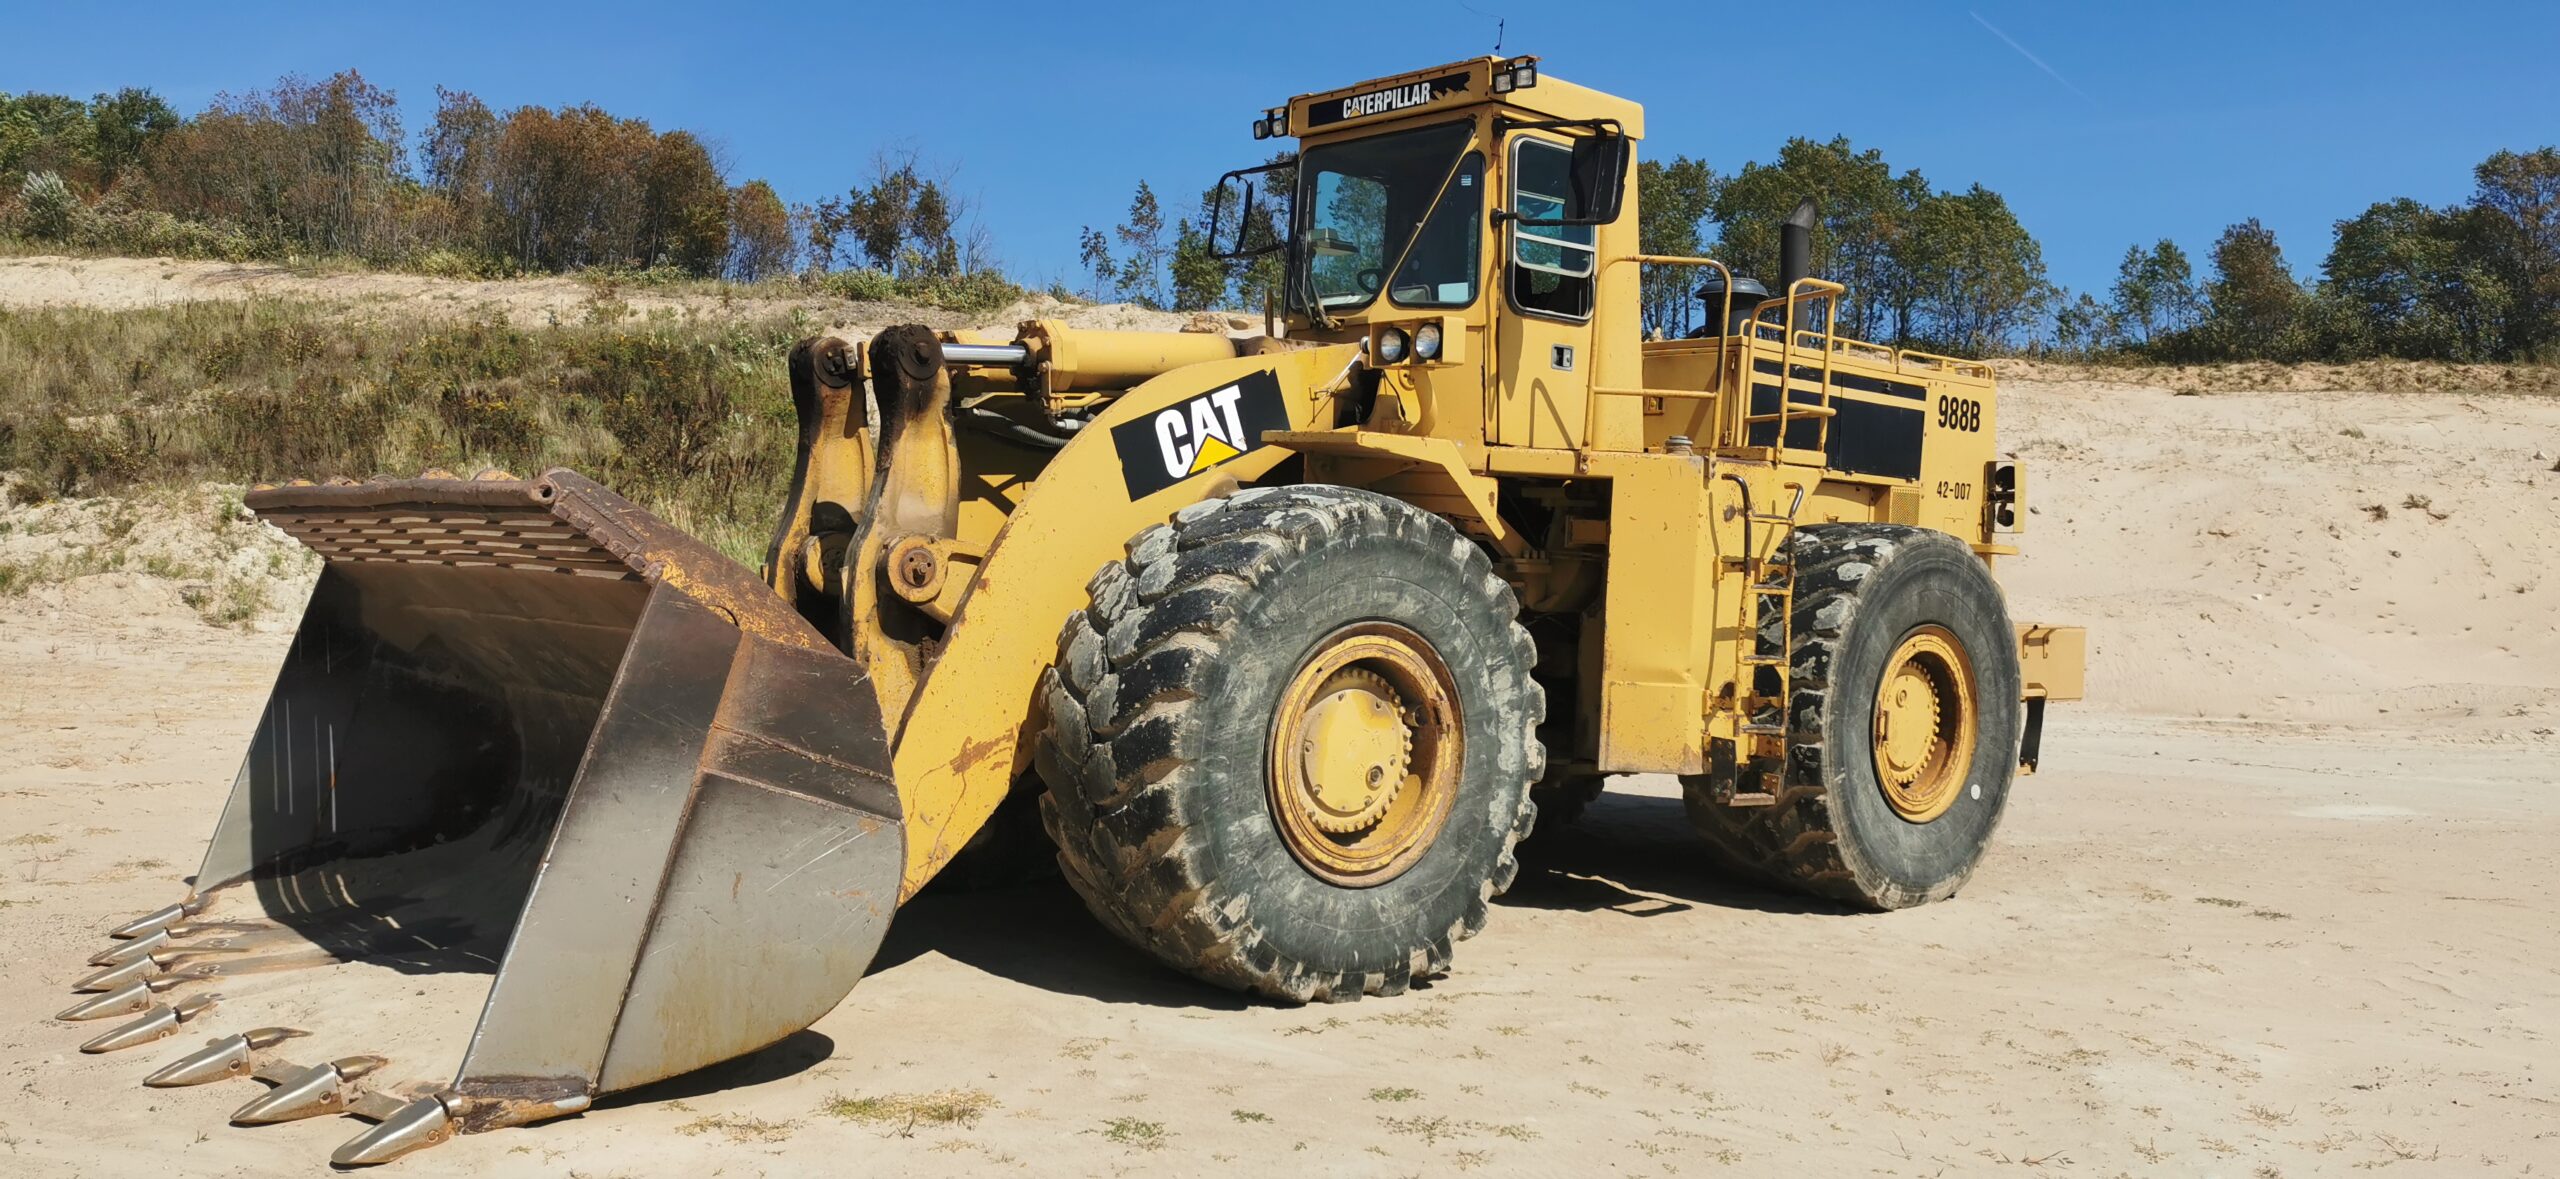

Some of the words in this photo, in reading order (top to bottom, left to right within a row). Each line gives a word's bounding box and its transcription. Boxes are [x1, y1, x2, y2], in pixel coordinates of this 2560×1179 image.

[1343, 82, 1431, 119] CATERPILLAR
[1155, 384, 1247, 479] CAT
[1938, 395, 1981, 433] 988B
[1936, 481, 1972, 500] 42-007
